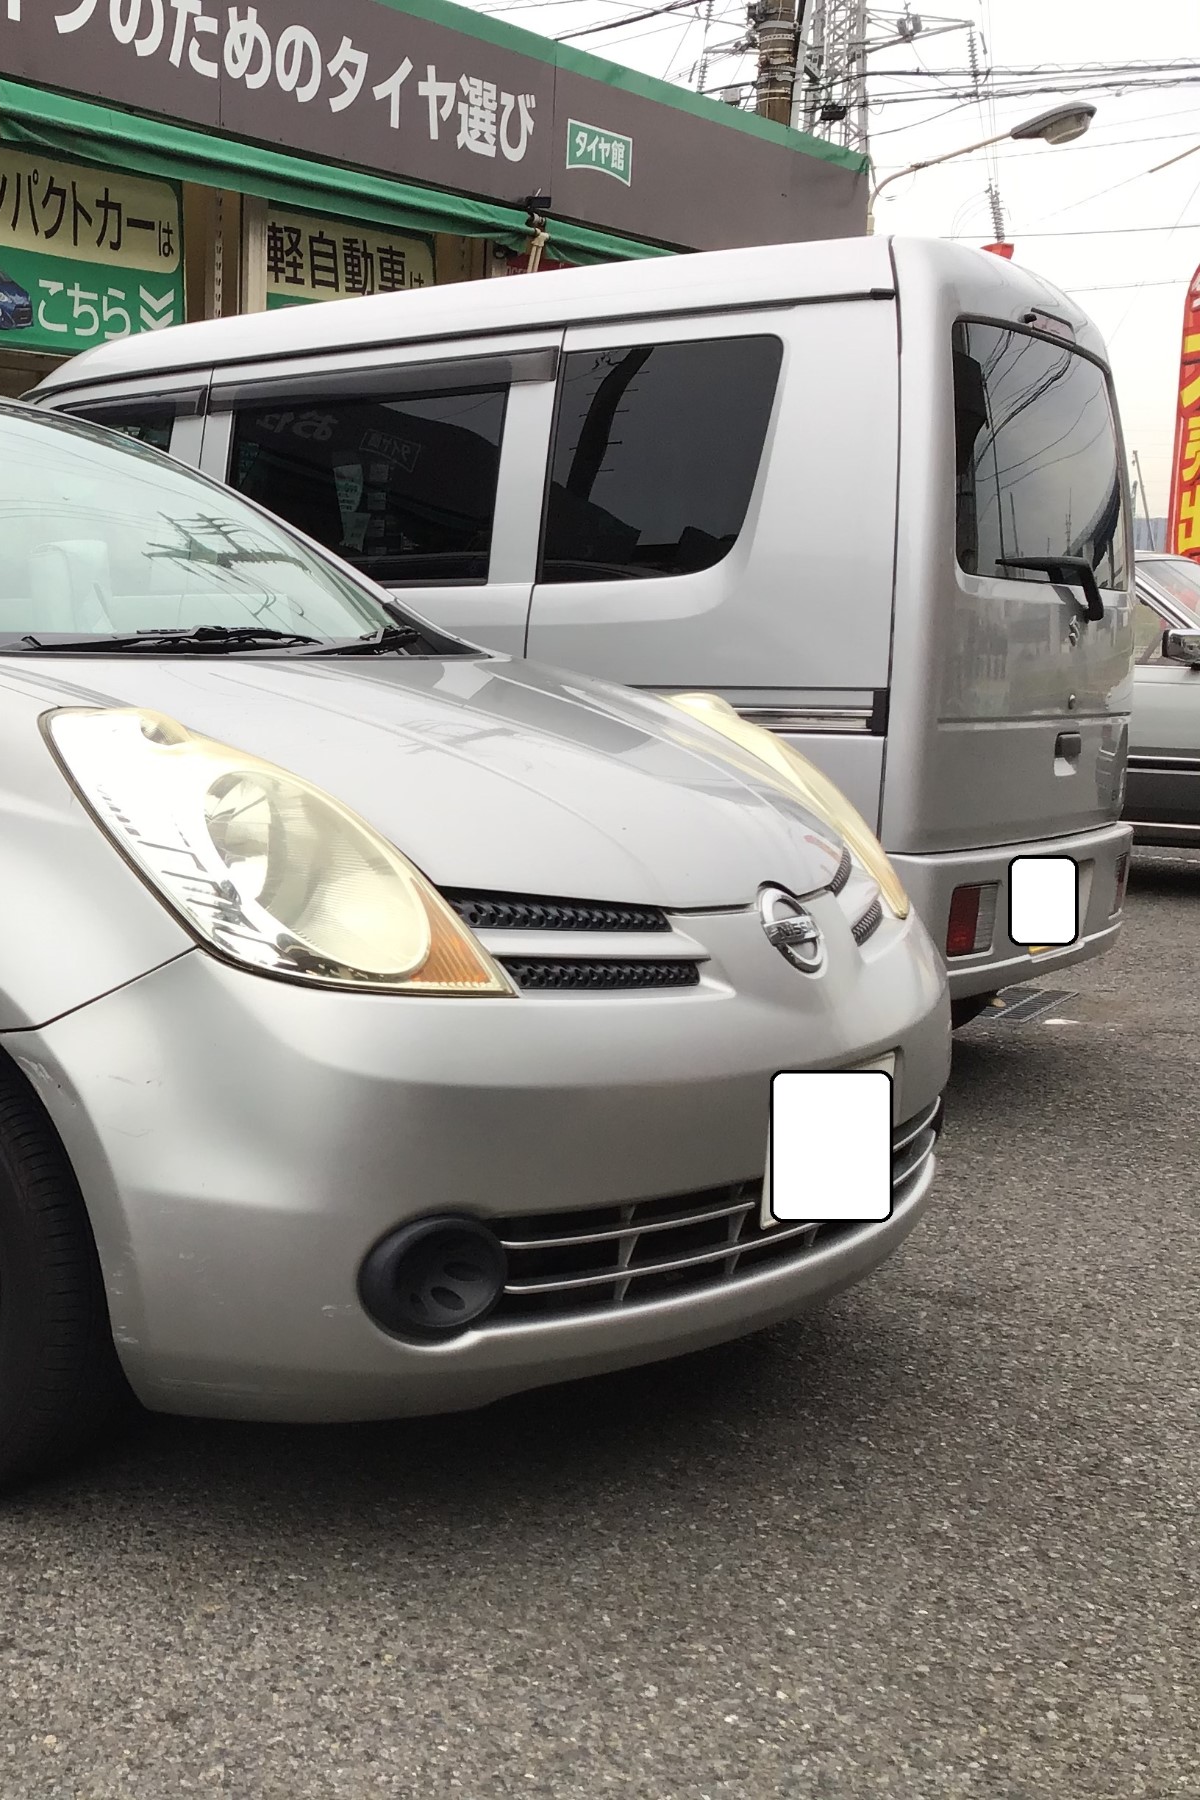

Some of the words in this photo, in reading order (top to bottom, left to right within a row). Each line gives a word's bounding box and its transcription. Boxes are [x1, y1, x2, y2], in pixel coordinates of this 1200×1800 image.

[8, 0, 537, 163] のためのタイヤ選び
[575, 131, 625, 171] タイヤ館
[37, 279, 131, 339] こちら
